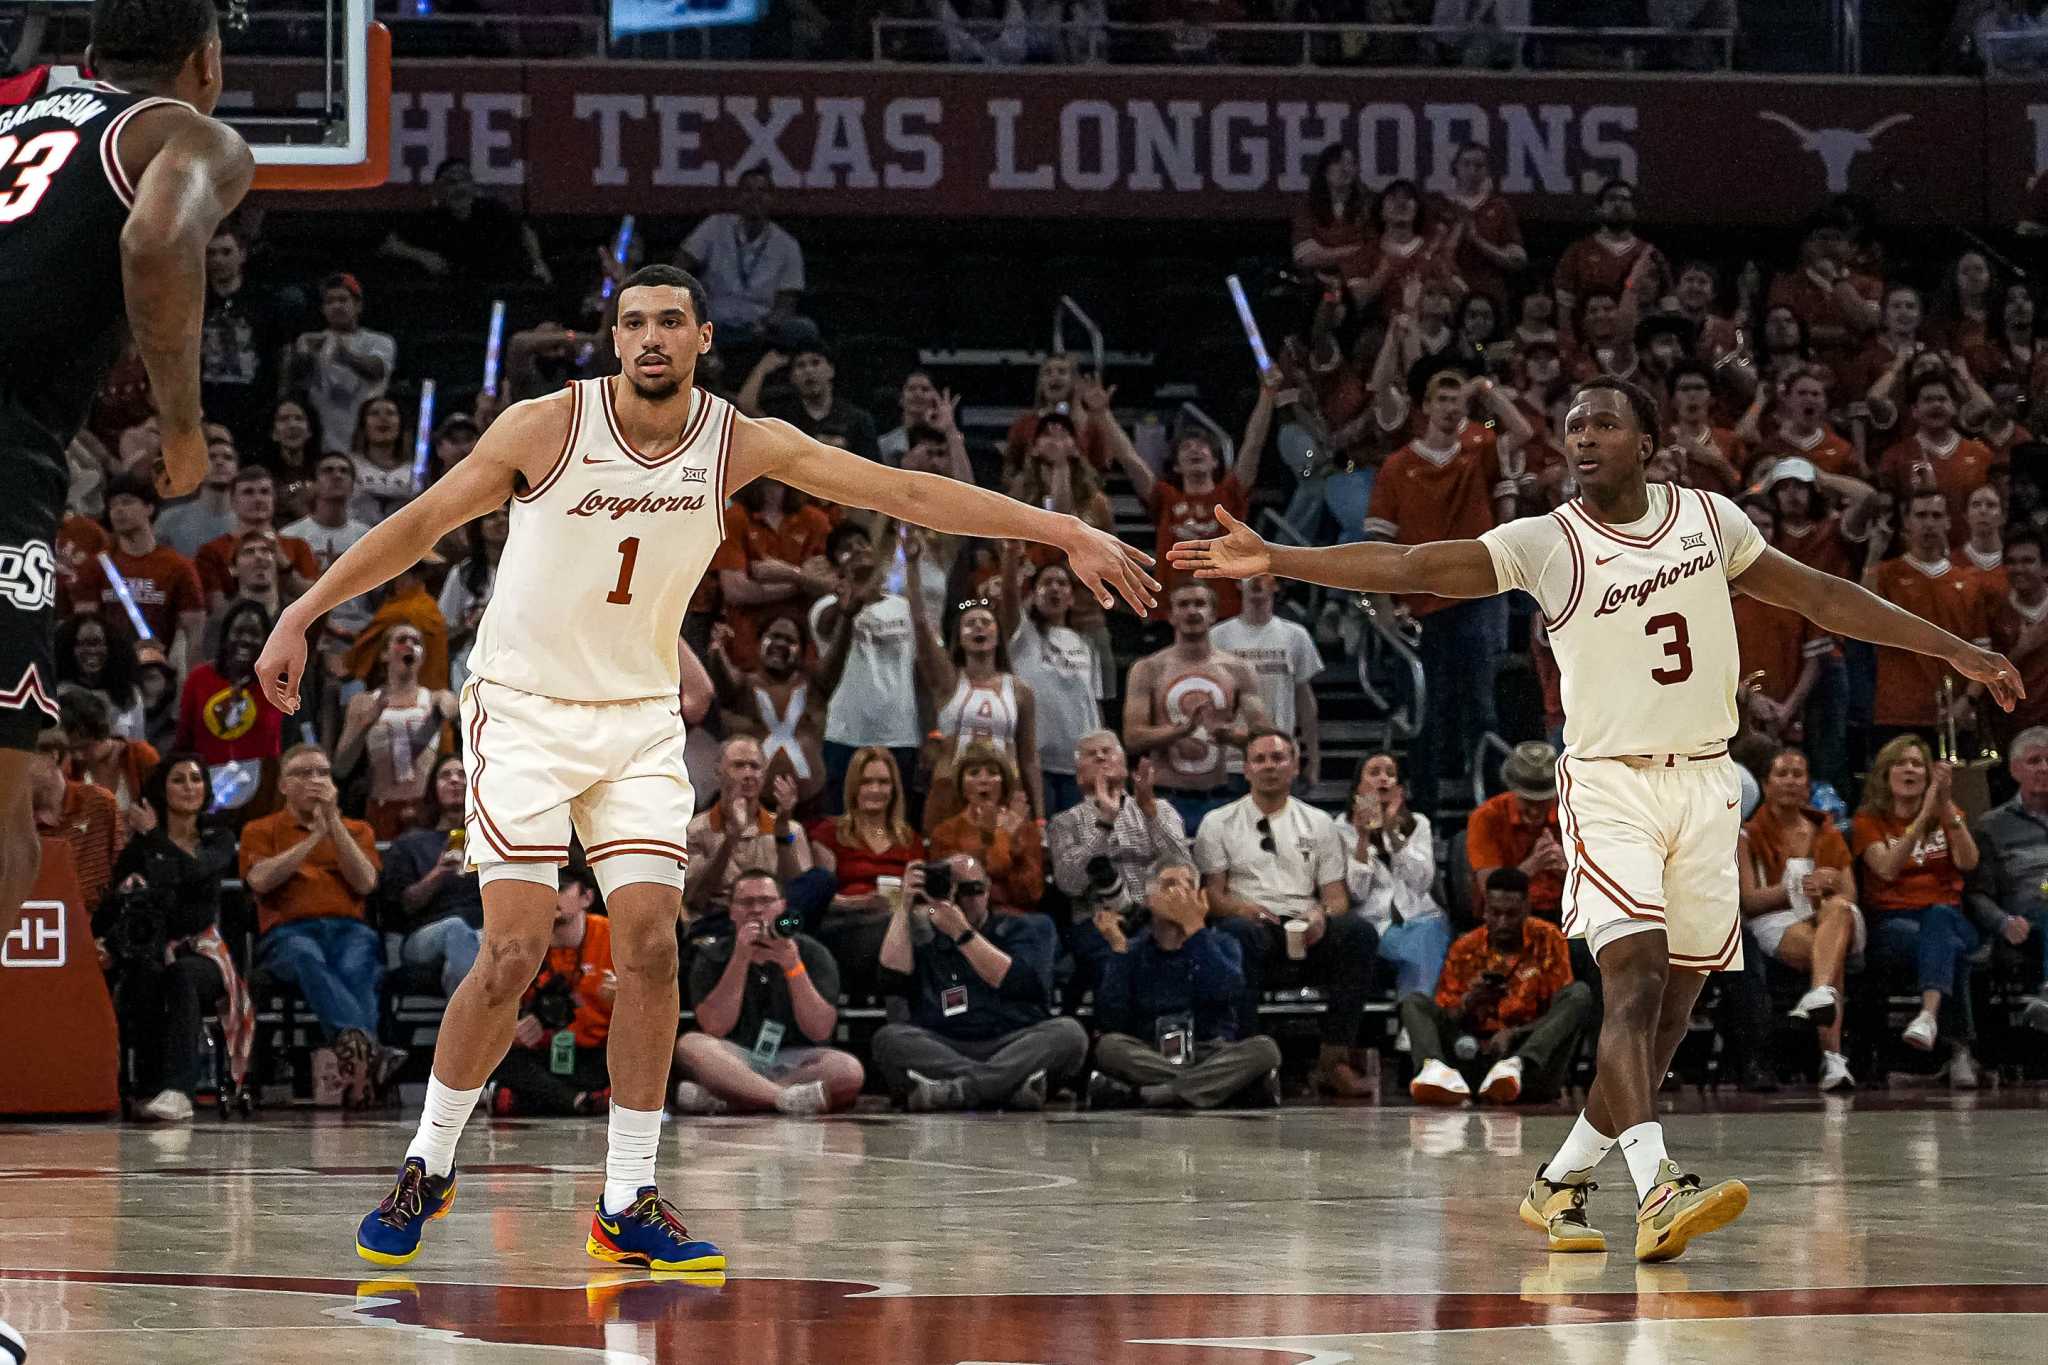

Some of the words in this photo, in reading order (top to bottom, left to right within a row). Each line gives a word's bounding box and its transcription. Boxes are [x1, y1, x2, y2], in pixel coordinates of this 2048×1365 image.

[0, 130, 80, 224] 3
[574, 94, 943, 188] TEXAS
[987, 100, 1639, 193] LONGHORNS
[566, 488, 706, 521] Longhorns
[606, 536, 640, 605] 1
[1594, 550, 1717, 618] Longhorns
[1645, 612, 1693, 685] 3
